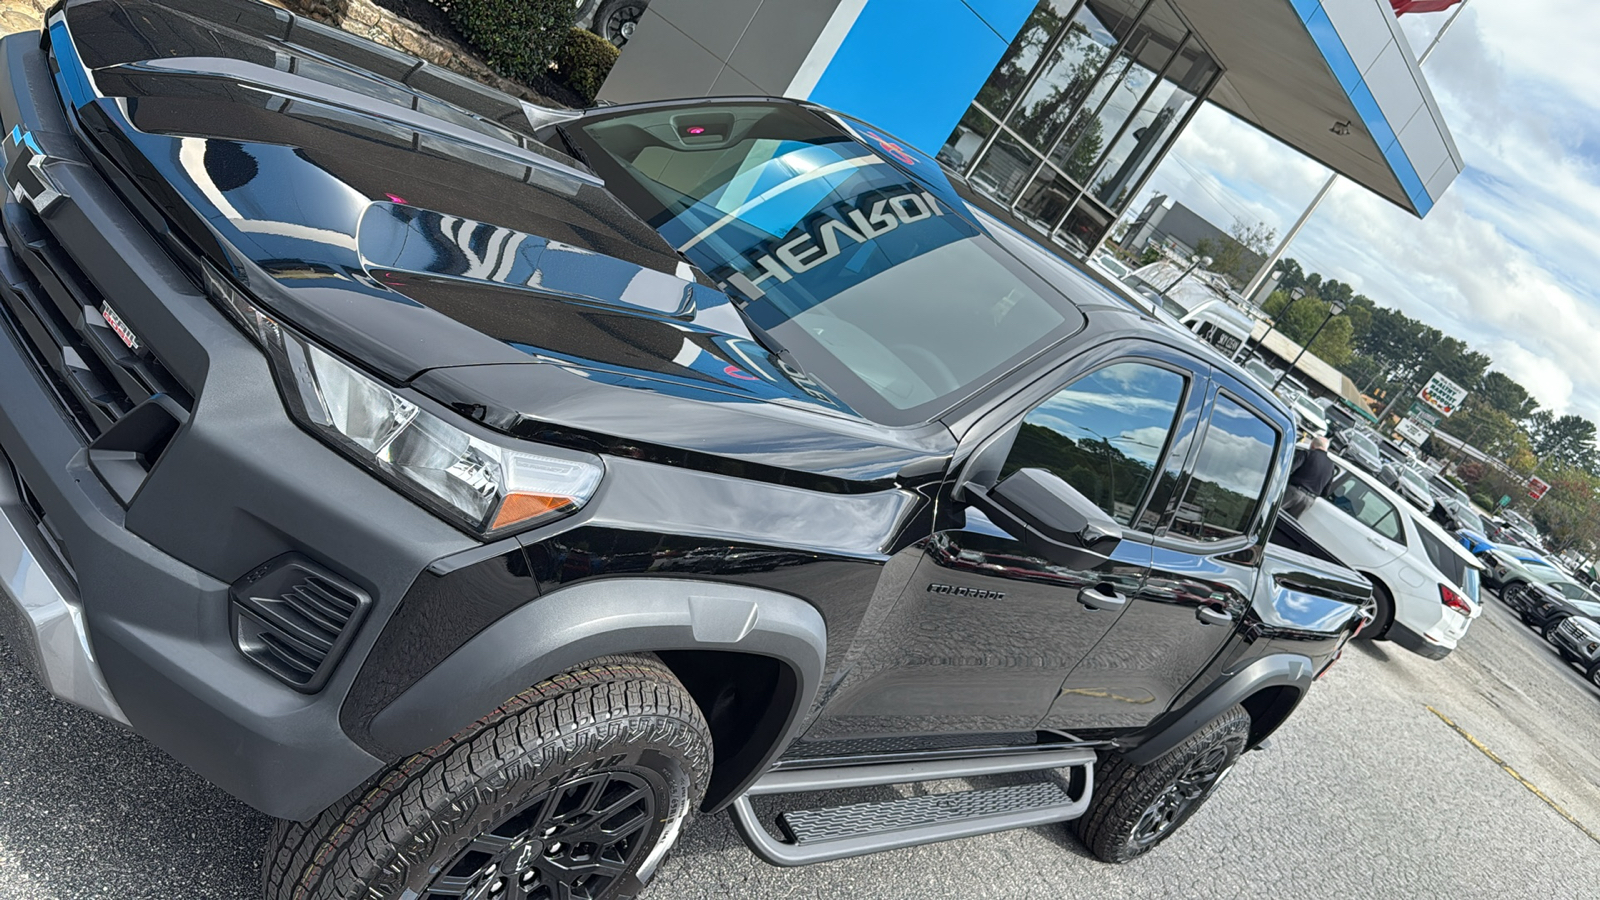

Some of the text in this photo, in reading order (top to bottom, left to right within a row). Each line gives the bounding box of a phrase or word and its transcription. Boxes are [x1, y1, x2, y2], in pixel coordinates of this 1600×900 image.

[103, 300, 139, 349] TRAIL
[103, 312, 133, 348] BOSS
[1430, 384, 1456, 403] HARVEST
[1431, 378, 1457, 396] HEALTHY
[927, 583, 1005, 601] COLORADO
